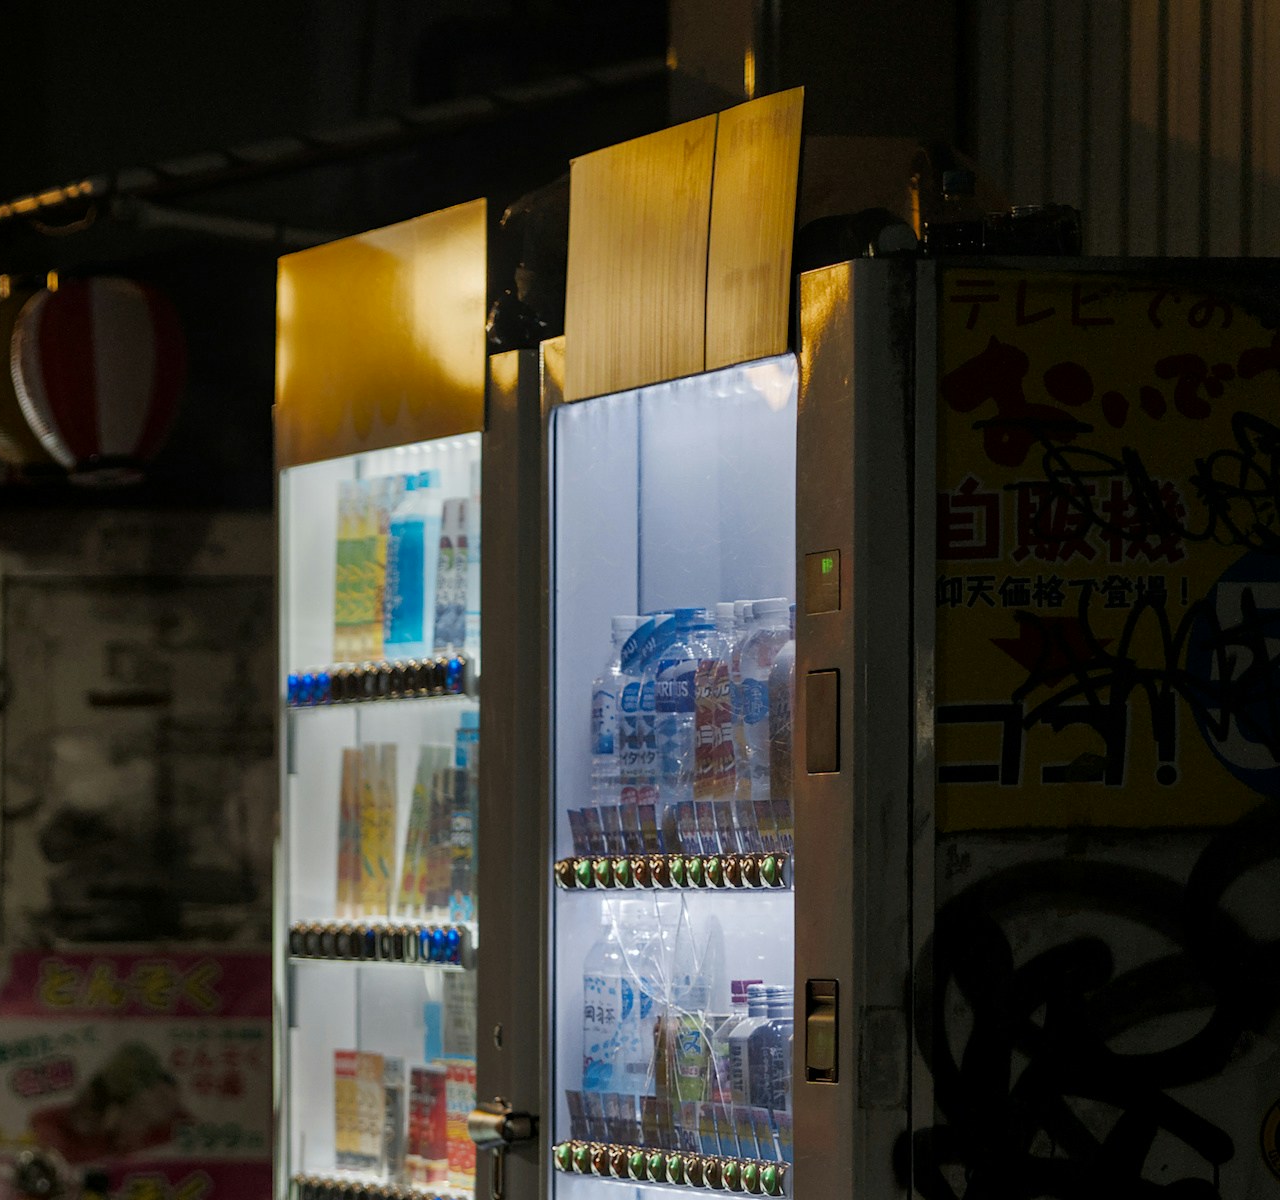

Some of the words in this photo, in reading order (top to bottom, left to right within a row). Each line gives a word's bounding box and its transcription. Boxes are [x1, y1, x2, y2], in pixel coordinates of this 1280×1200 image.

[936, 475, 1186, 564] 自販機
[40, 959, 221, 1011] とんそく
